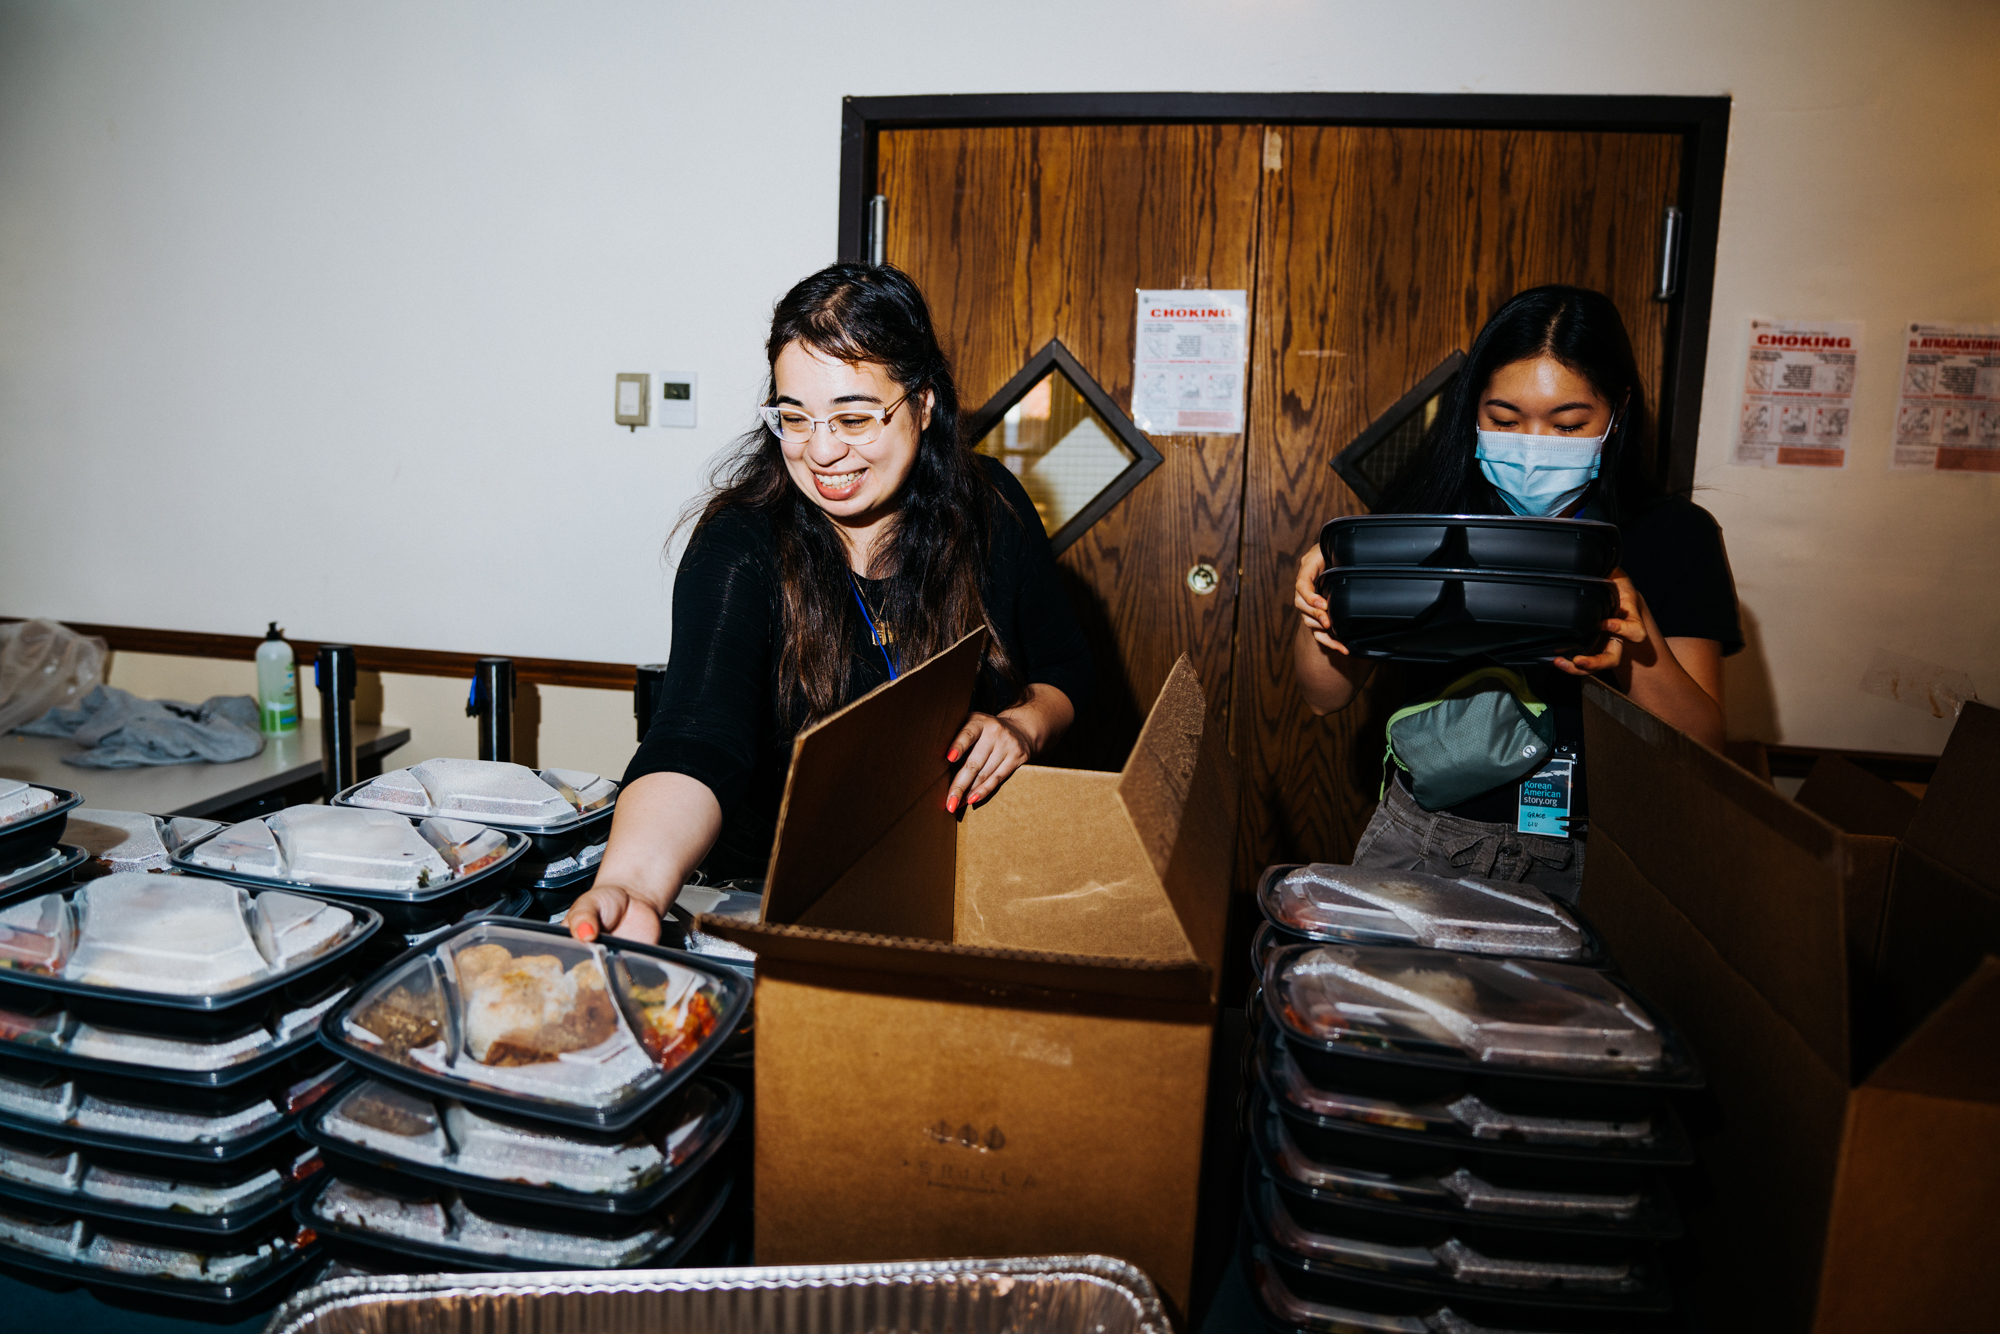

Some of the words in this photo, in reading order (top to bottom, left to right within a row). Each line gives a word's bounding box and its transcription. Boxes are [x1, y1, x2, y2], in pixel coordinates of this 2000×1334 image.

[1150, 308, 1232, 318] CHOKING
[1756, 334, 1852, 349] CHOKING
[1919, 337, 2000, 350] ATRAGANTAMI
[1524, 781, 1552, 790] Korean
[1523, 788, 1561, 798] American
[1523, 796, 1557, 807] story.org
[902, 1158, 1037, 1188] ERILLA
